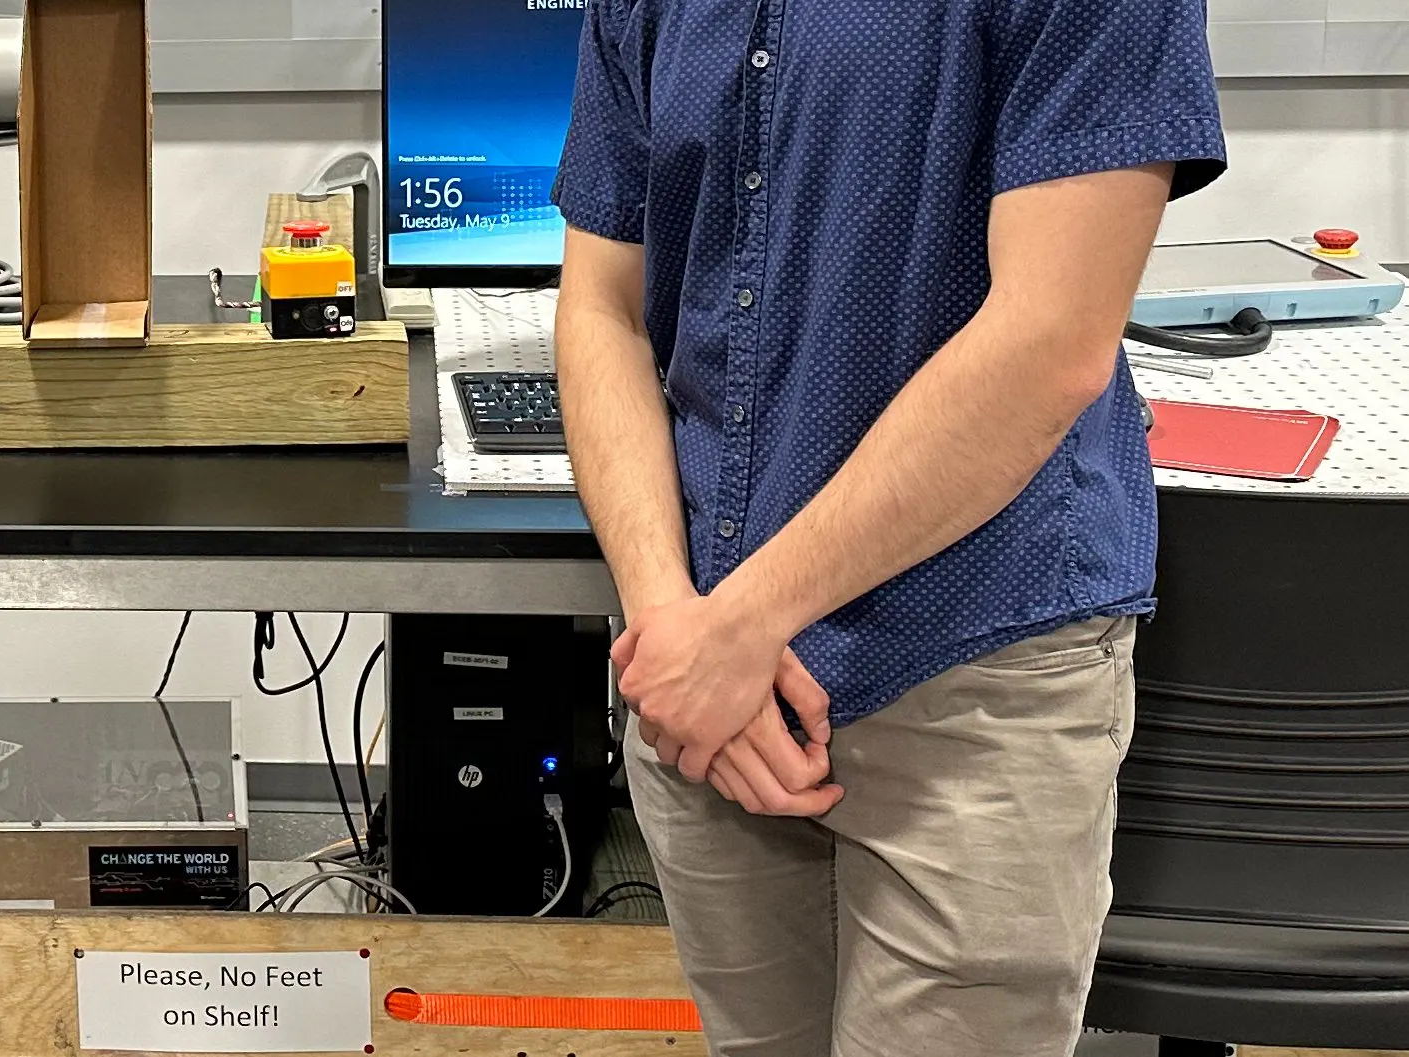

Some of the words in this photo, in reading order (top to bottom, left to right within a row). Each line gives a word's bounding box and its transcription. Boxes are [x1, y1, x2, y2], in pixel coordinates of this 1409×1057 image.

[400, 177, 463, 208] 1:56
[399, 213, 461, 232] Tuesday,
[465, 213, 497, 232] May
[500, 213, 510, 225] 9
[101, 853, 154, 865] CHANGE
[156, 853, 181, 864] THE
[184, 853, 230, 864] WORLD
[186, 865, 211, 874] WITH
[214, 865, 228, 874] US
[120, 962, 211, 990] Please,
[220, 966, 257, 988] No
[266, 966, 323, 987] Feet
[163, 1008, 196, 1026] on
[204, 1005, 279, 1027] Shelf!
